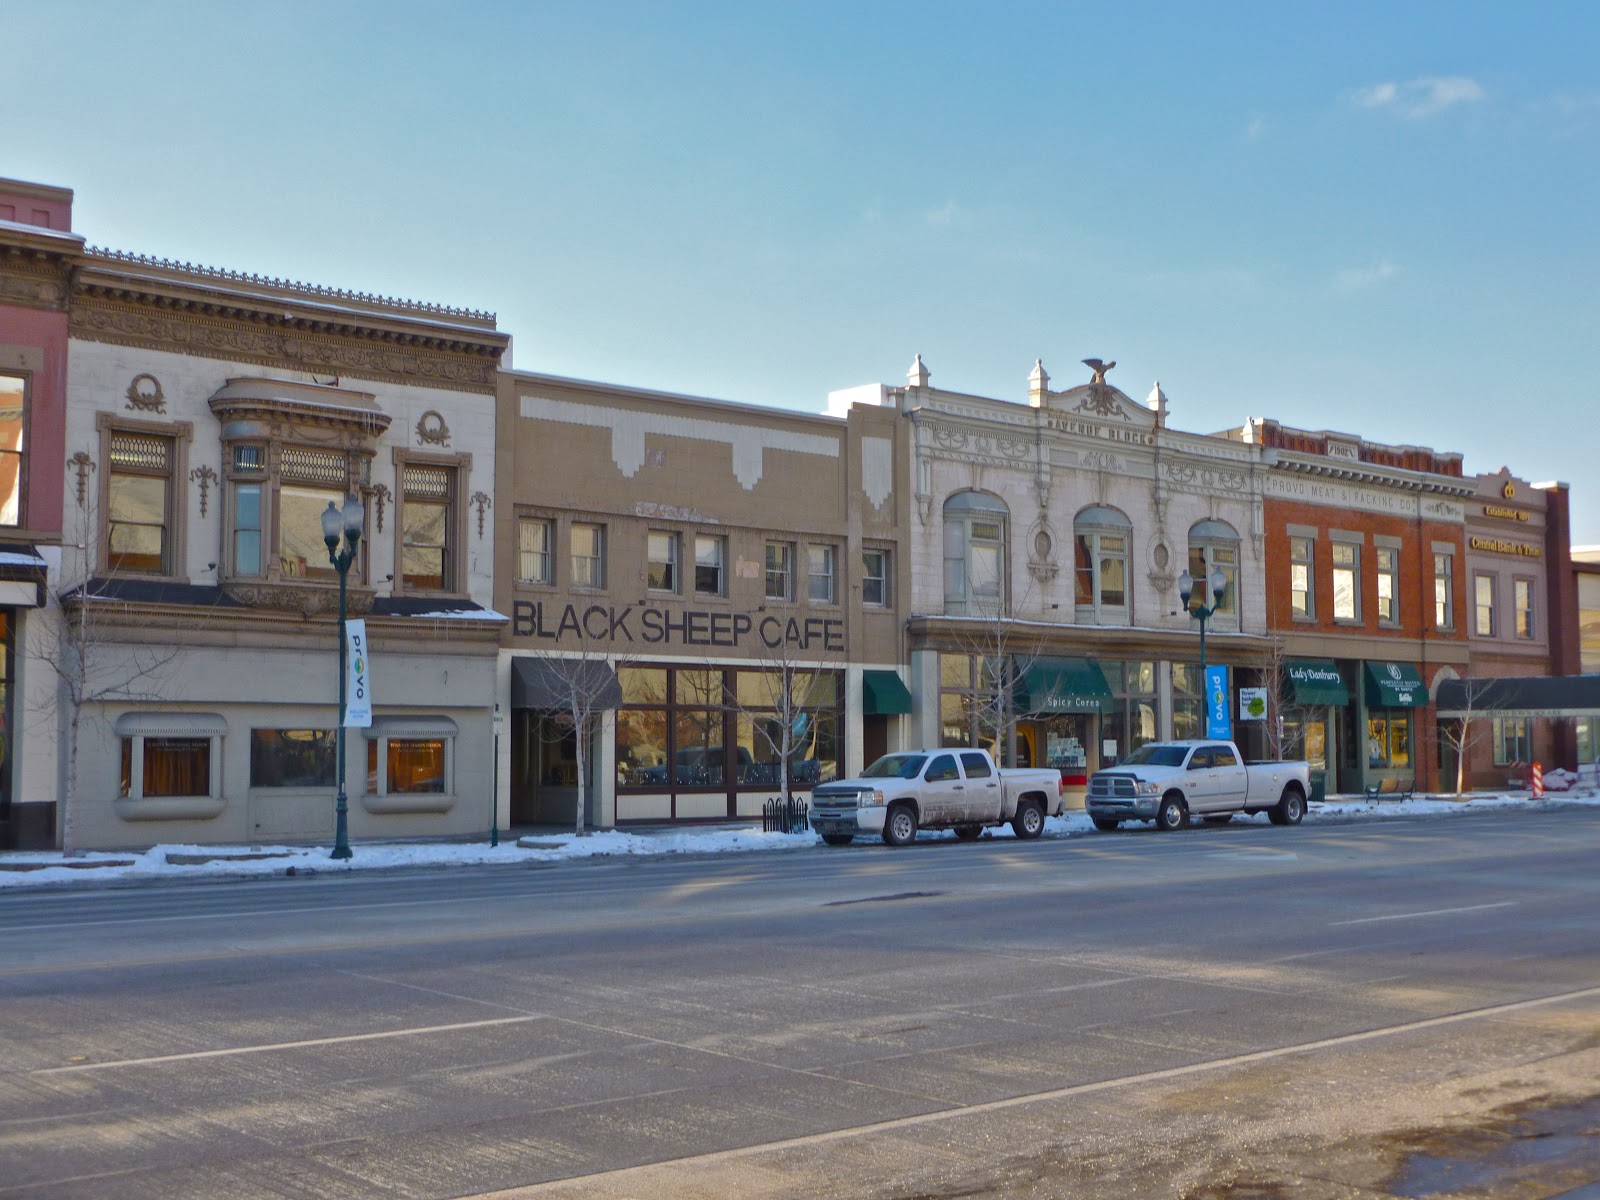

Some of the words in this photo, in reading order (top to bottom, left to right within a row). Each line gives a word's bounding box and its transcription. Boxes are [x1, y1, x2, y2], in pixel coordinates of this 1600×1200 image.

[1055, 419, 1101, 436] AVENUE
[1108, 428, 1146, 445] BLOCK
[1334, 446, 1350, 456] 1902
[1271, 479, 1305, 495] PROVO
[1311, 485, 1335, 501] MEAT
[1341, 490, 1348, 501] &
[1354, 491, 1394, 509] PACKING
[1472, 535, 1497, 551] Central
[1497, 541, 1517, 554] Bank
[513, 601, 635, 643] BLACK
[641, 608, 752, 648] SHEEP
[759, 616, 845, 652] CAFE
[1289, 667, 1308, 683] Lady
[1047, 697, 1072, 708] Spicy
[1075, 697, 1100, 707] Corea
